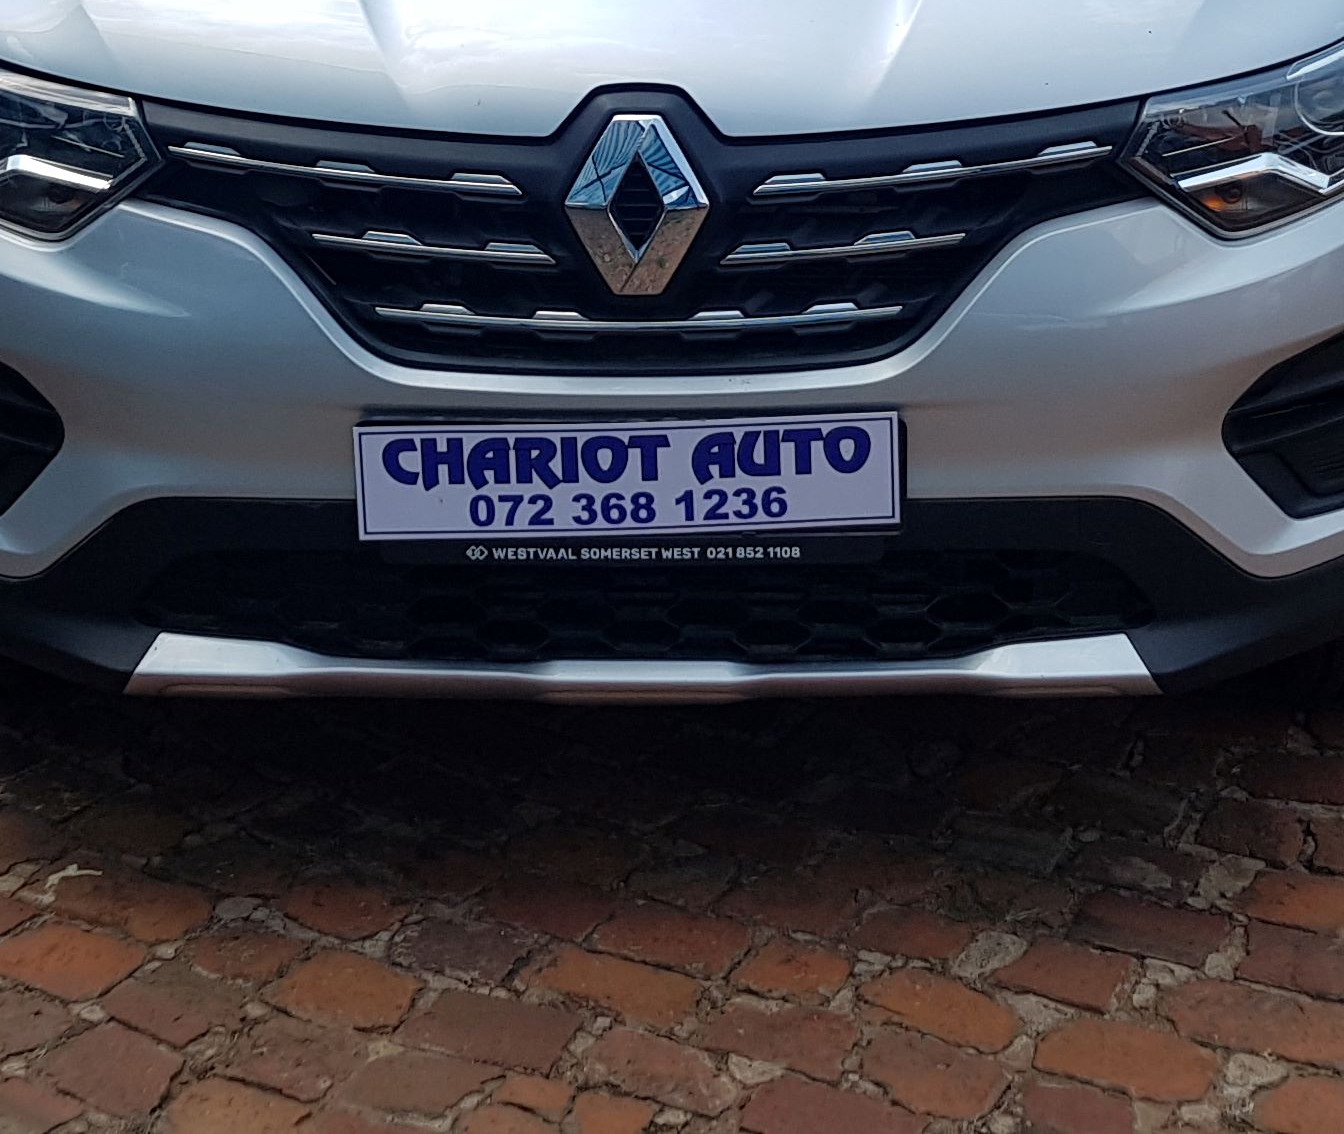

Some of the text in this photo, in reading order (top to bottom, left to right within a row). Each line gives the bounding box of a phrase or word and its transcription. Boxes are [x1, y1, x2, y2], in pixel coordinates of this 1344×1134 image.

[382, 426, 871, 491] CHARIOT AUTO
[469, 486, 788, 527] 072 368 1236
[492, 547, 801, 560] WESTVAAL SOMERSET WEST 021 852 1108
